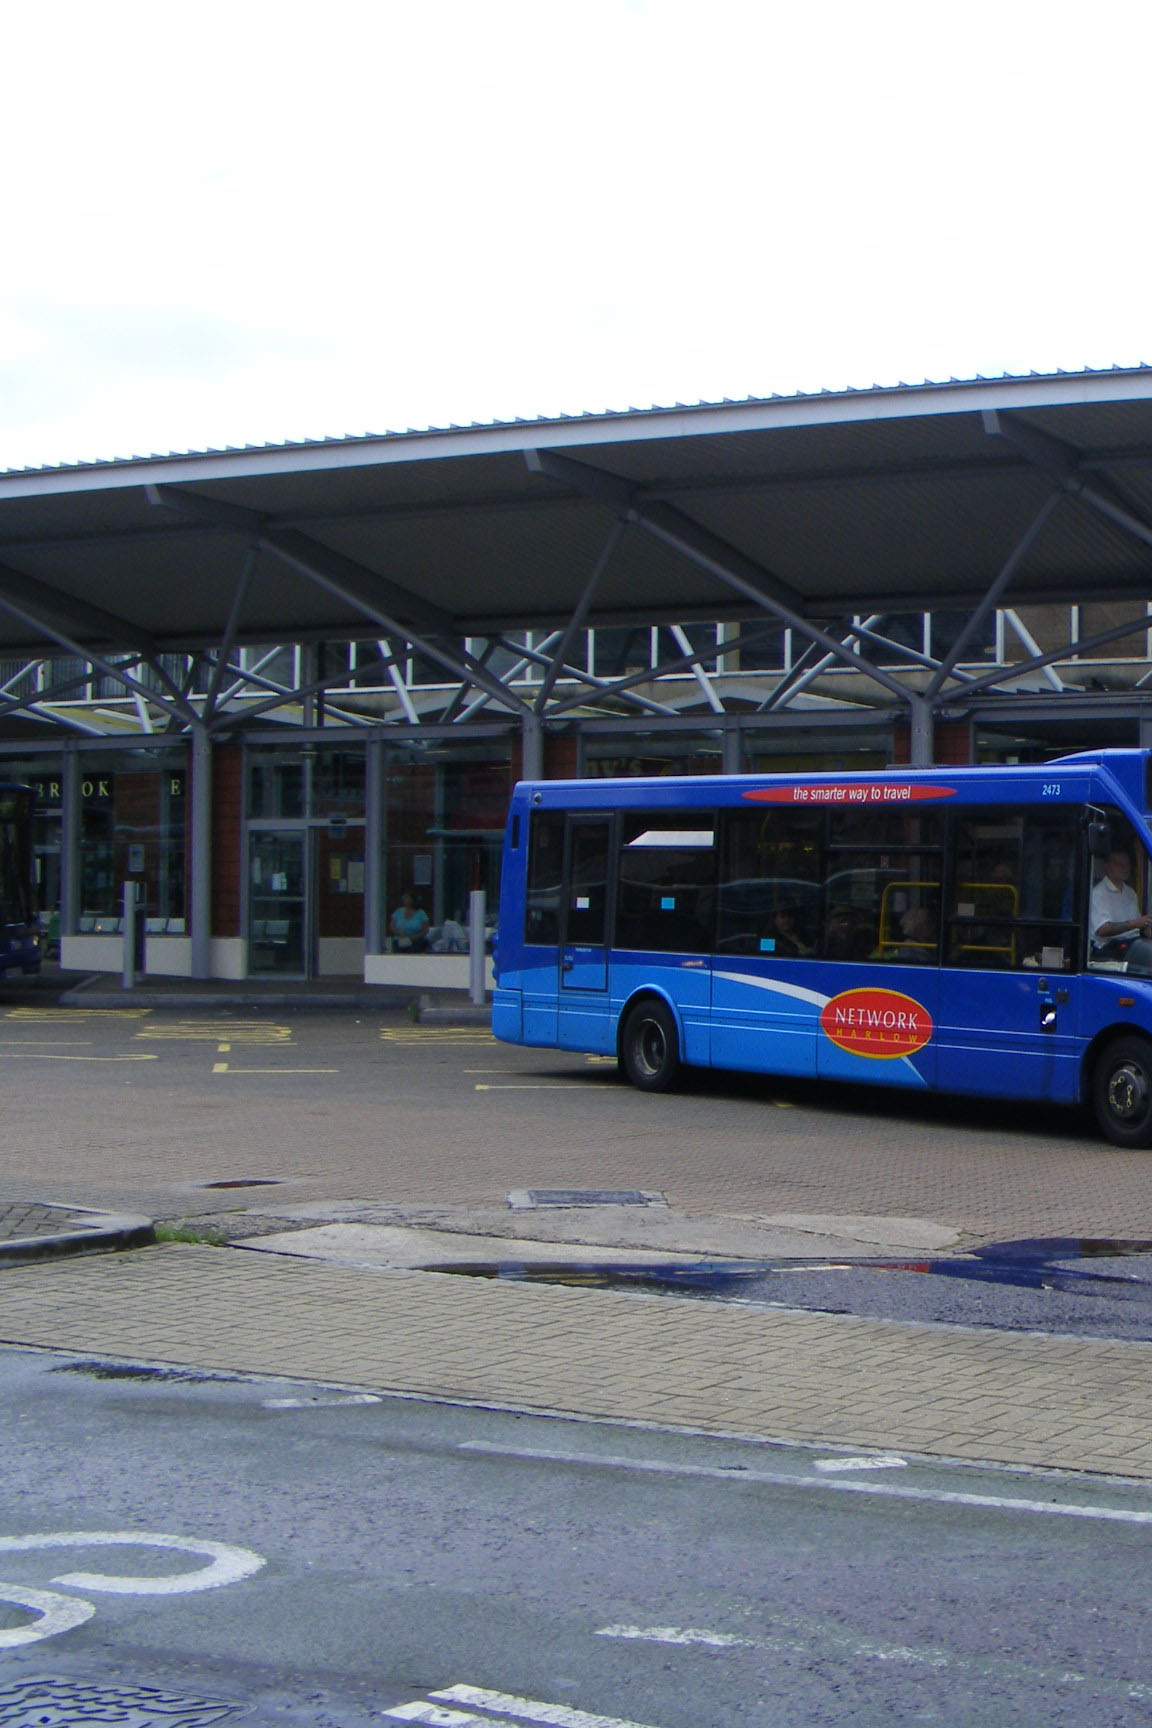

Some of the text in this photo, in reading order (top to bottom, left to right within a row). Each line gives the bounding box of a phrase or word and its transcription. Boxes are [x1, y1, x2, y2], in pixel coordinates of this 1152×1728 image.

[793, 786, 911, 803] the smarter way to travel
[1042, 784, 1061, 796] 2473
[835, 1006, 919, 1030] NETWORK
[836, 1028, 919, 1044] HARLOW
